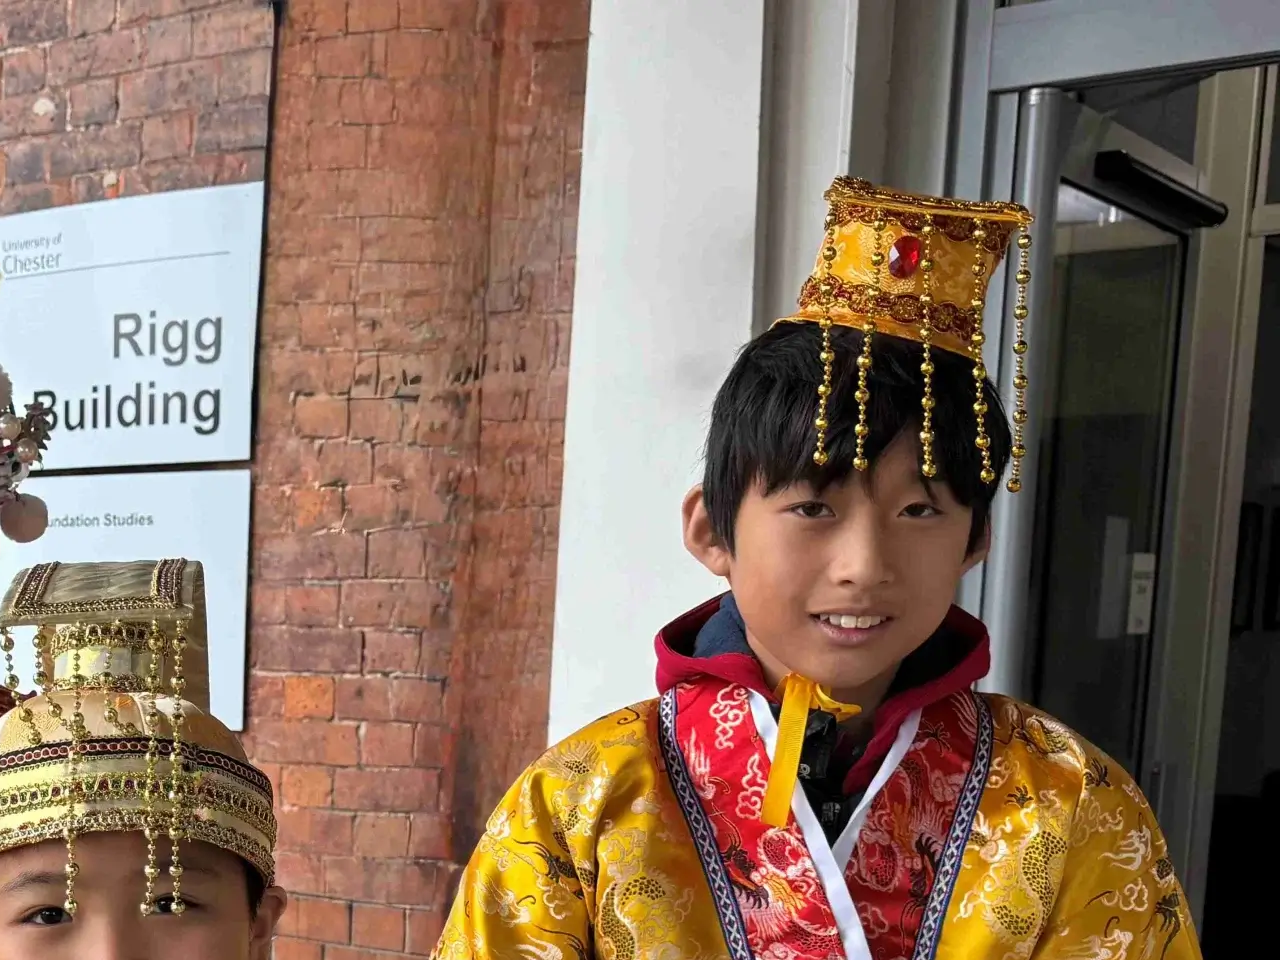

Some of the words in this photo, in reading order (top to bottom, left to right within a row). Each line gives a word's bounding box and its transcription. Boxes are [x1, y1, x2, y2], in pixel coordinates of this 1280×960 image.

[2, 236, 50, 252] University
[52, 232, 62, 245] of
[2, 252, 62, 274] Chester
[113, 310, 222, 366] Rigg
[33, 380, 221, 435] Building
[47, 514, 100, 527] undation
[103, 512, 154, 527] Studies
